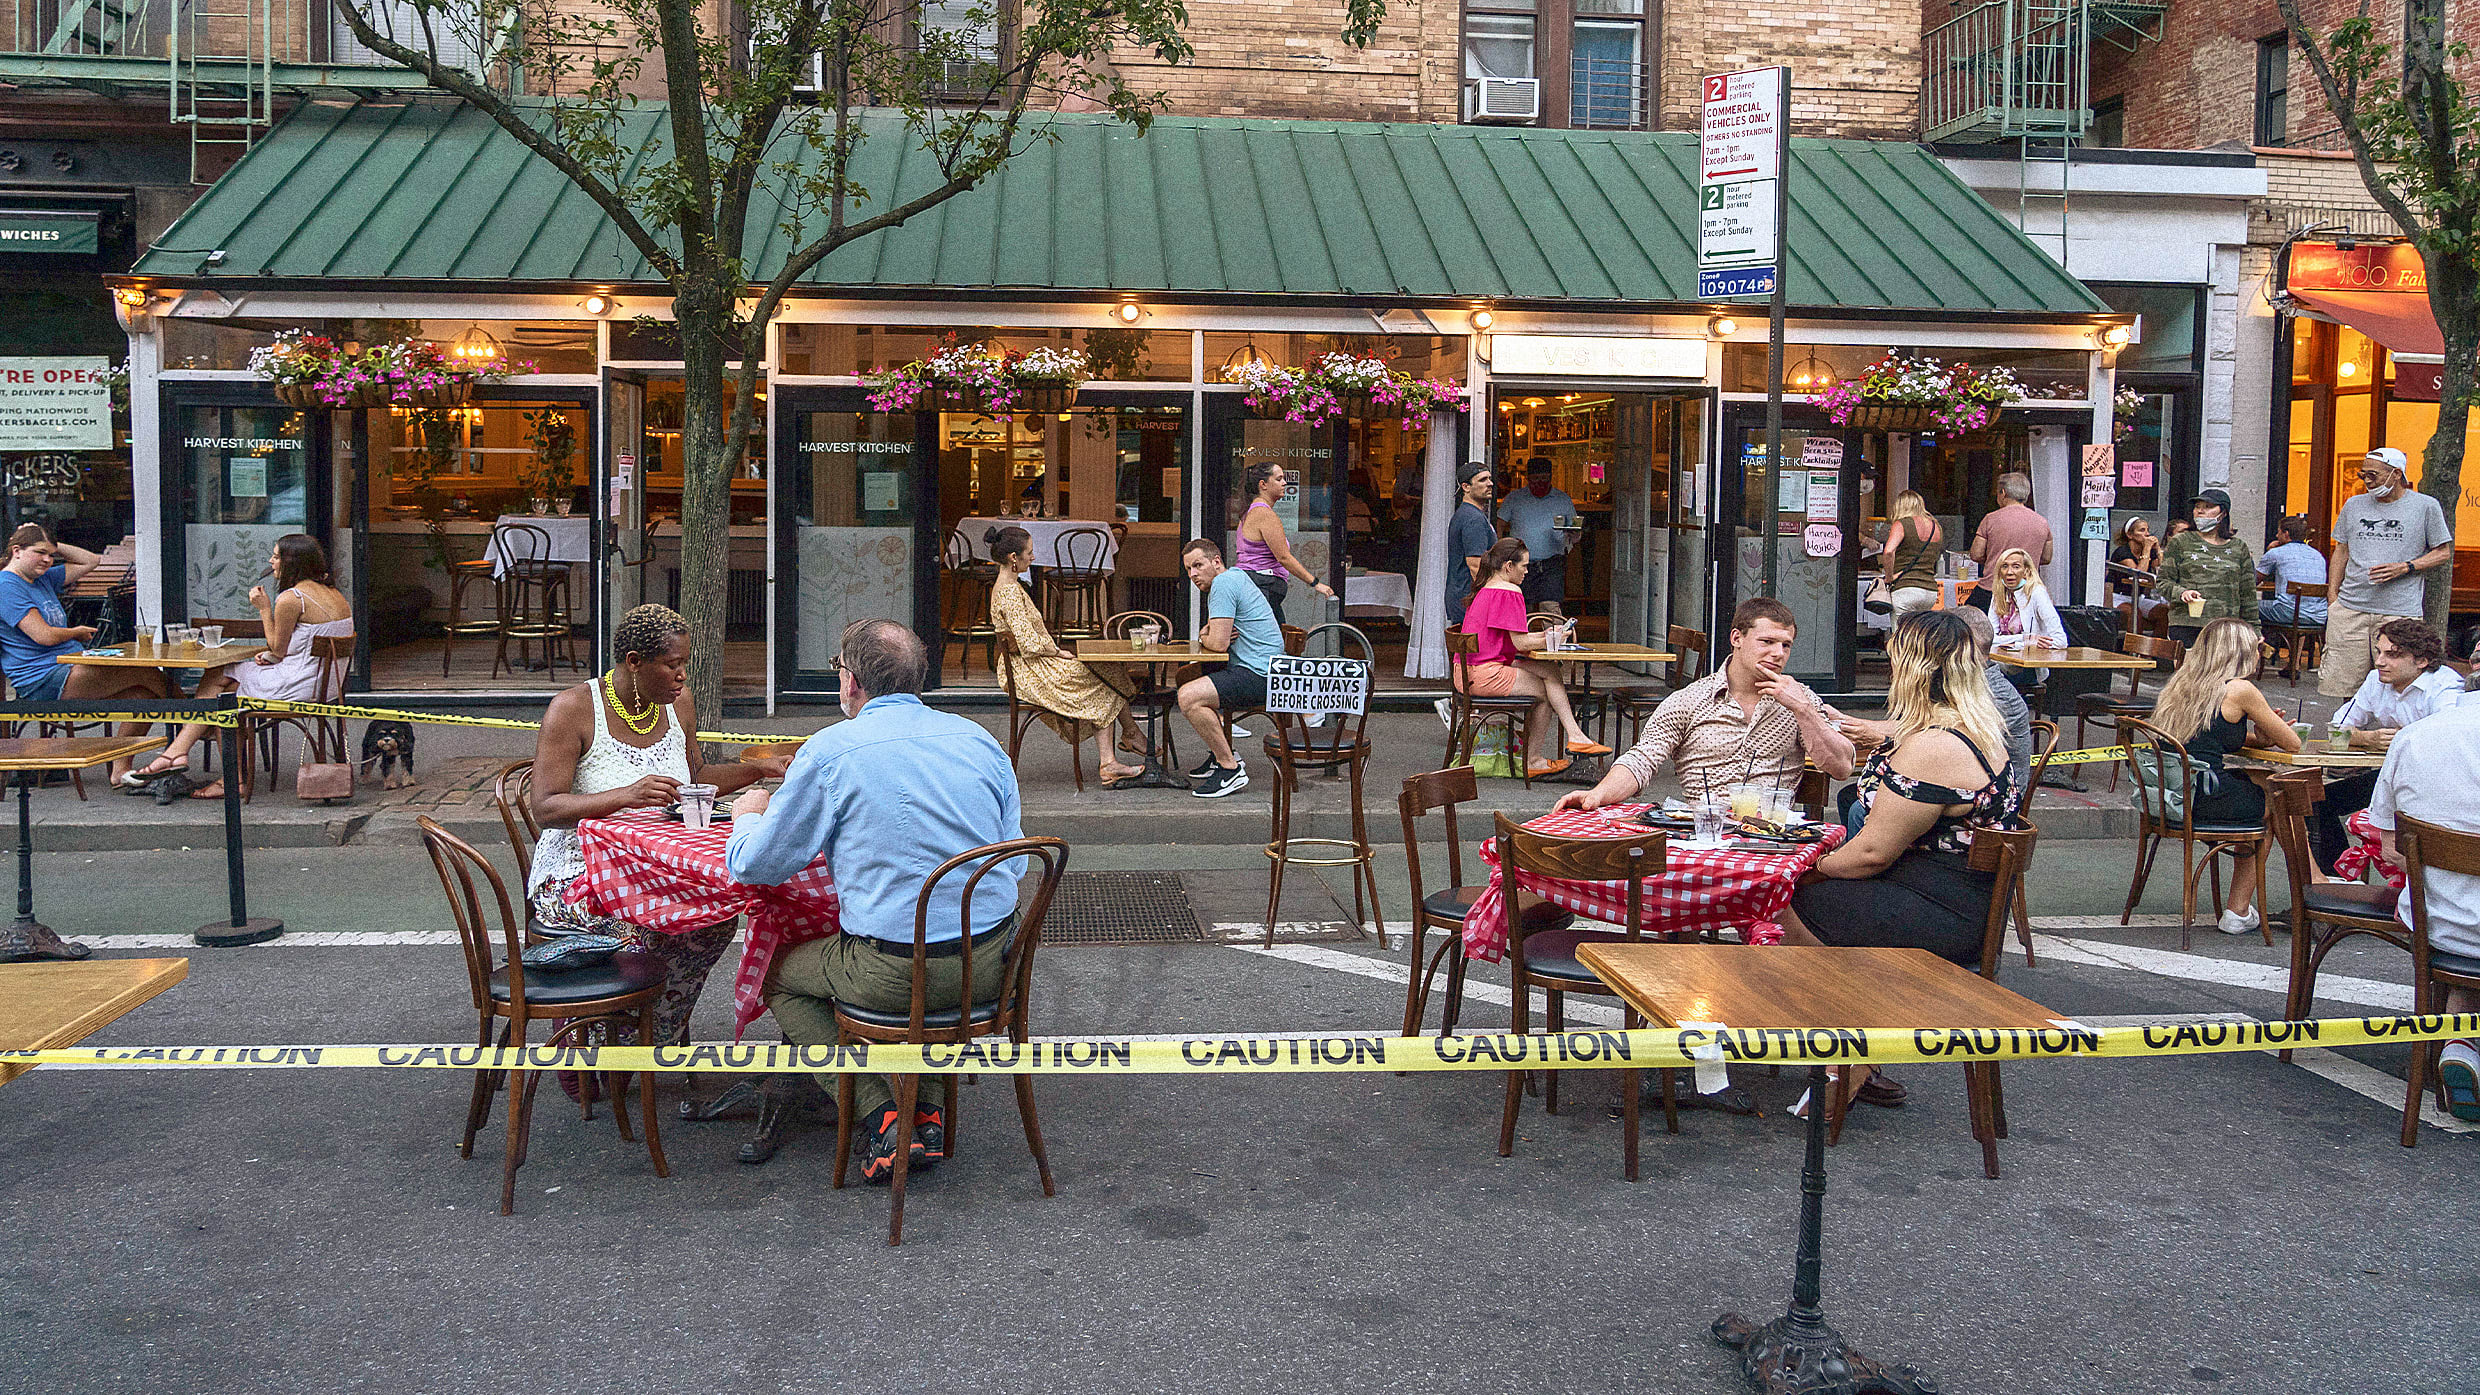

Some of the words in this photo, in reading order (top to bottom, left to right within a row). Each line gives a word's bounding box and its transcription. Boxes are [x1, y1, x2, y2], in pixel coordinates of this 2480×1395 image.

[1710, 78, 1723, 100] 2
[1729, 82, 1755, 91] metered
[1729, 91, 1752, 100] parking
[1706, 102, 1761, 118] COMMERCIAL
[1707, 115, 1746, 129] VEHICLES
[1749, 112, 1770, 124] ONLY
[1706, 132, 1729, 142] OTHERS
[1731, 131, 1740, 139] NO
[1742, 127, 1773, 137] STANDING
[1706, 147, 1720, 155] 7am
[1726, 145, 1740, 153] 1pm
[1705, 155, 1728, 165] Except
[1729, 152, 1755, 163] Sunday
[1707, 186, 1720, 208] 2
[1726, 192, 1752, 200] metered
[1726, 200, 1748, 209] parking
[1704, 220, 1717, 228] 1pm
[1723, 217, 1738, 226] 7pm
[0, 230, 60, 241] WICHES
[1703, 229, 1726, 238] Except
[1728, 226, 1753, 236] Sunday
[1701, 279, 1756, 295] 109074
[1136, 421, 1180, 431] HARVEST
[184, 437, 244, 448] HARVEST
[247, 438, 302, 450] KITCHEN
[799, 442, 856, 453] HARVEST
[858, 443, 911, 454] KITCHEN
[1232, 447, 1285, 457] HARVEST
[1740, 456, 1790, 467] HARST
[1808, 527, 1838, 538] Harvest
[1290, 660, 1346, 677] LOOK
[1270, 676, 1313, 692] BOTH
[1318, 679, 1360, 693] WAYS
[1270, 693, 1308, 709] BEFORE
[1310, 694, 1359, 710] CROSSING
[1914, 1027, 2099, 1056] CAUTION
[2143, 1019, 2319, 1049] CAUTION
[1434, 1031, 1632, 1063] CAUTION
[1677, 1028, 1869, 1059] CAUTION
[378, 1047, 599, 1067] CAUTION
[653, 1044, 868, 1068] CAUTION
[922, 1042, 1131, 1068] CAUTION
[1182, 1037, 1386, 1066] CAUTION
